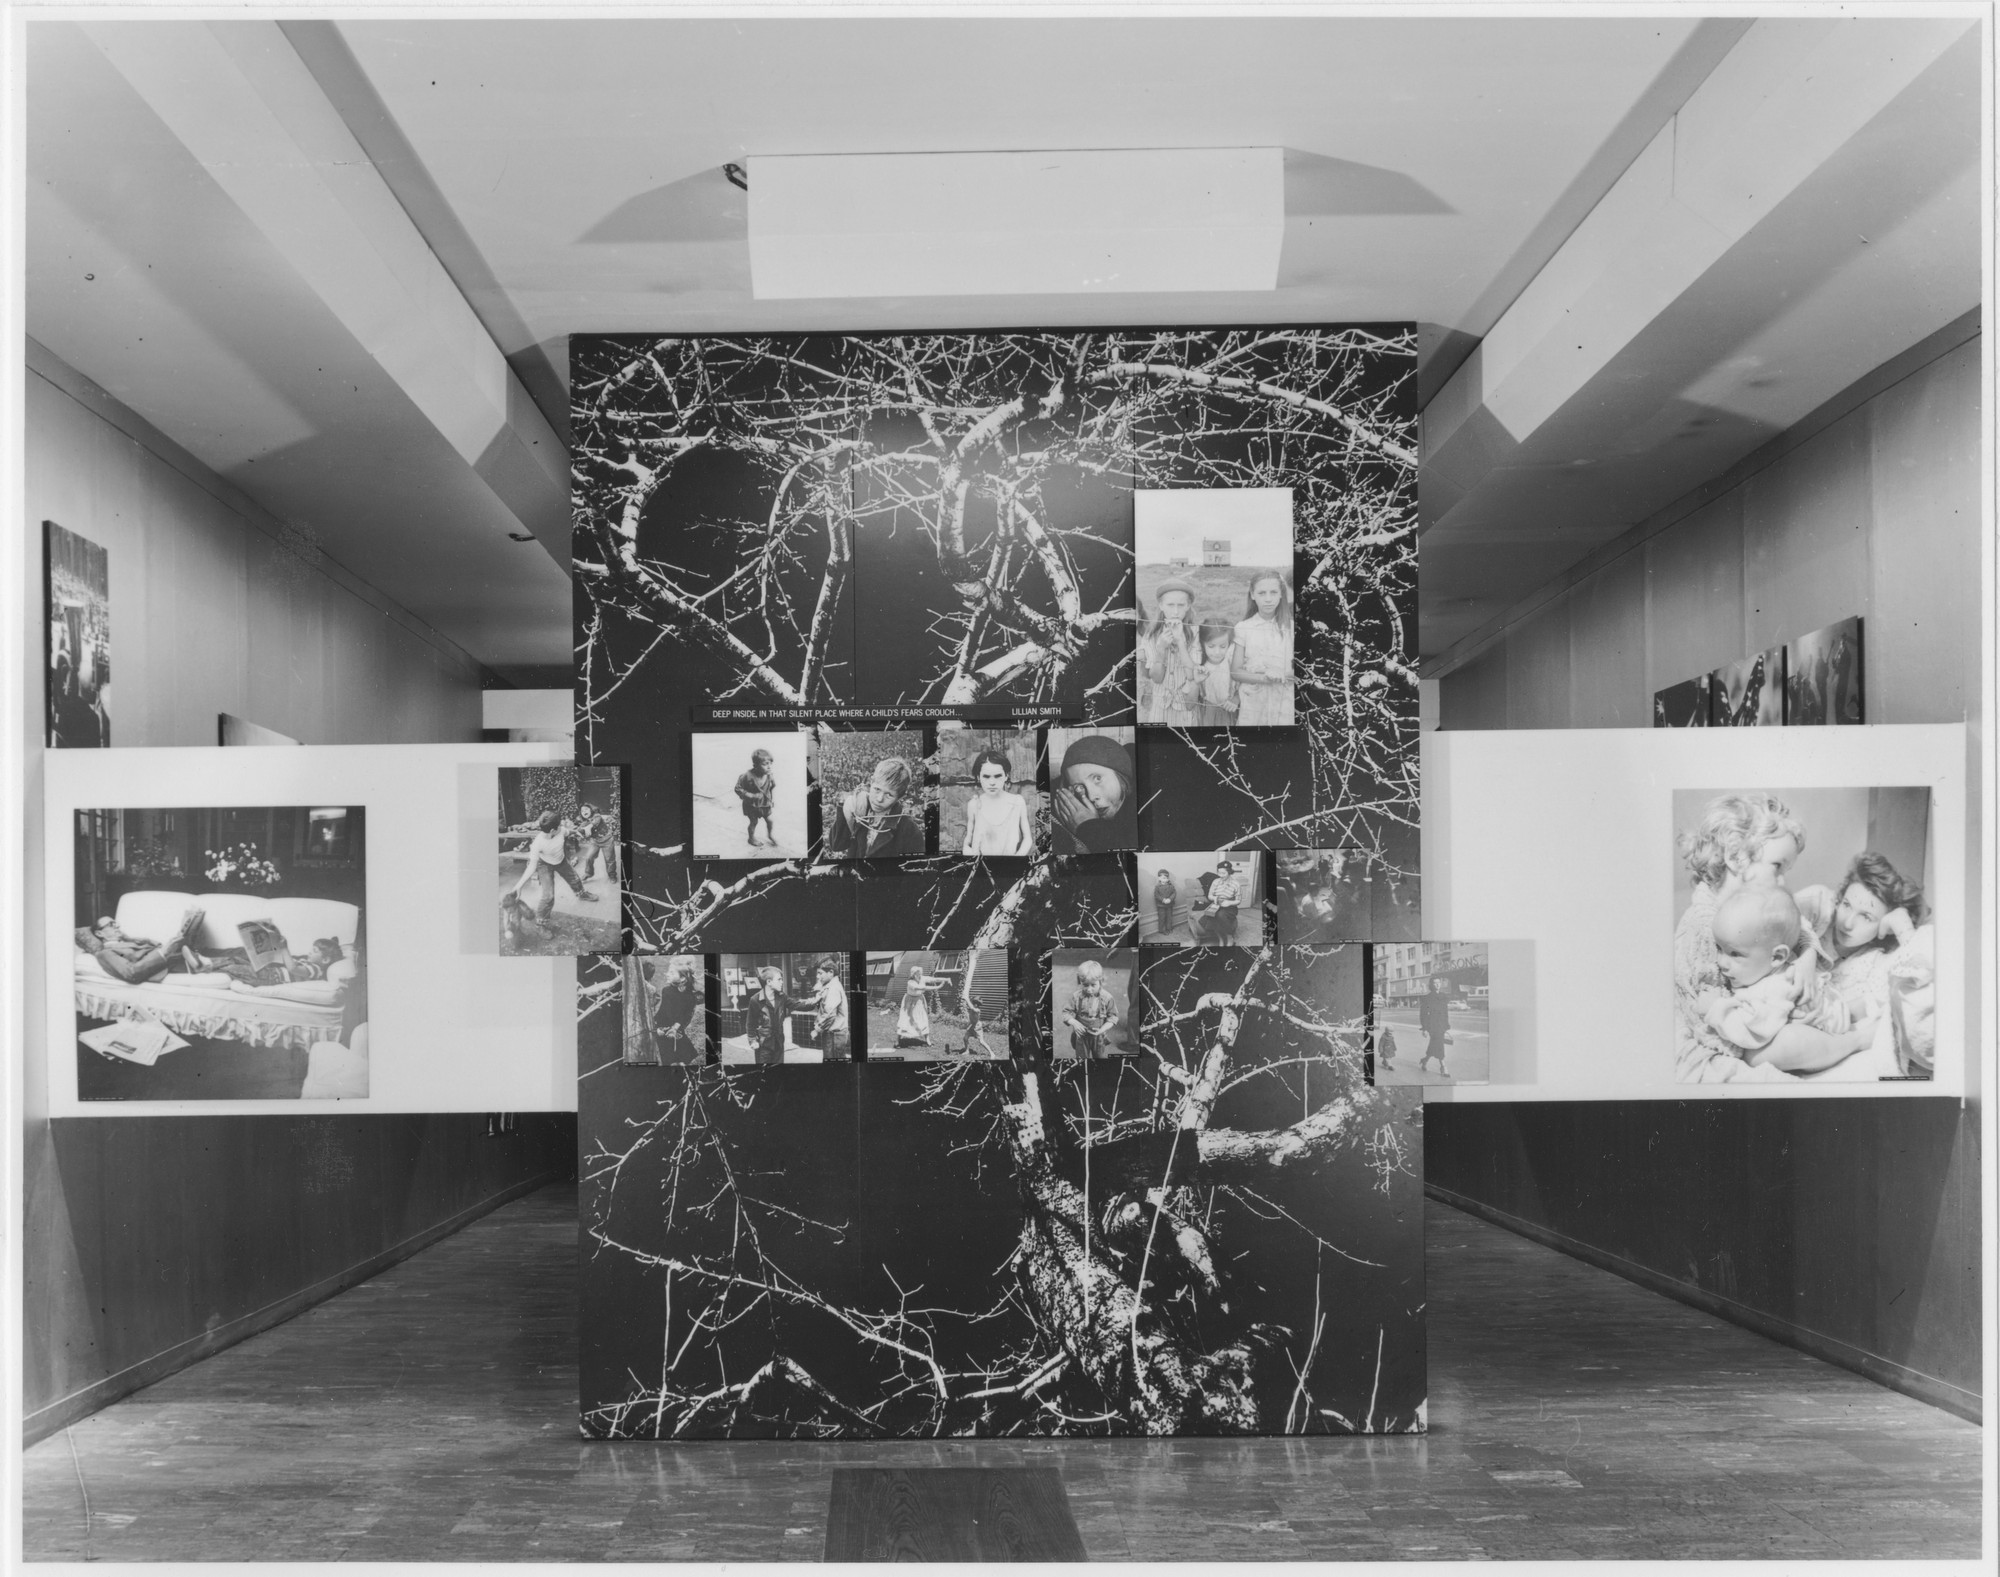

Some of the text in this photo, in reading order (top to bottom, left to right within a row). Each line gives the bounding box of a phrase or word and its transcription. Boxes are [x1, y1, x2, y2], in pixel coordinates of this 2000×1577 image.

[712, 710, 731, 718] DEEP
[732, 710, 758, 719] INSIDE,
[758, 710, 766, 718] IN
[768, 710, 786, 718] THAT
[788, 709, 812, 718] SILENT
[814, 709, 836, 718] PLACE
[838, 708, 864, 718] WHERE
[865, 708, 870, 717] A
[872, 708, 898, 717] CHILD'S
[900, 708, 924, 717] FEARS
[1012, 708, 1038, 716] LILLIAN
